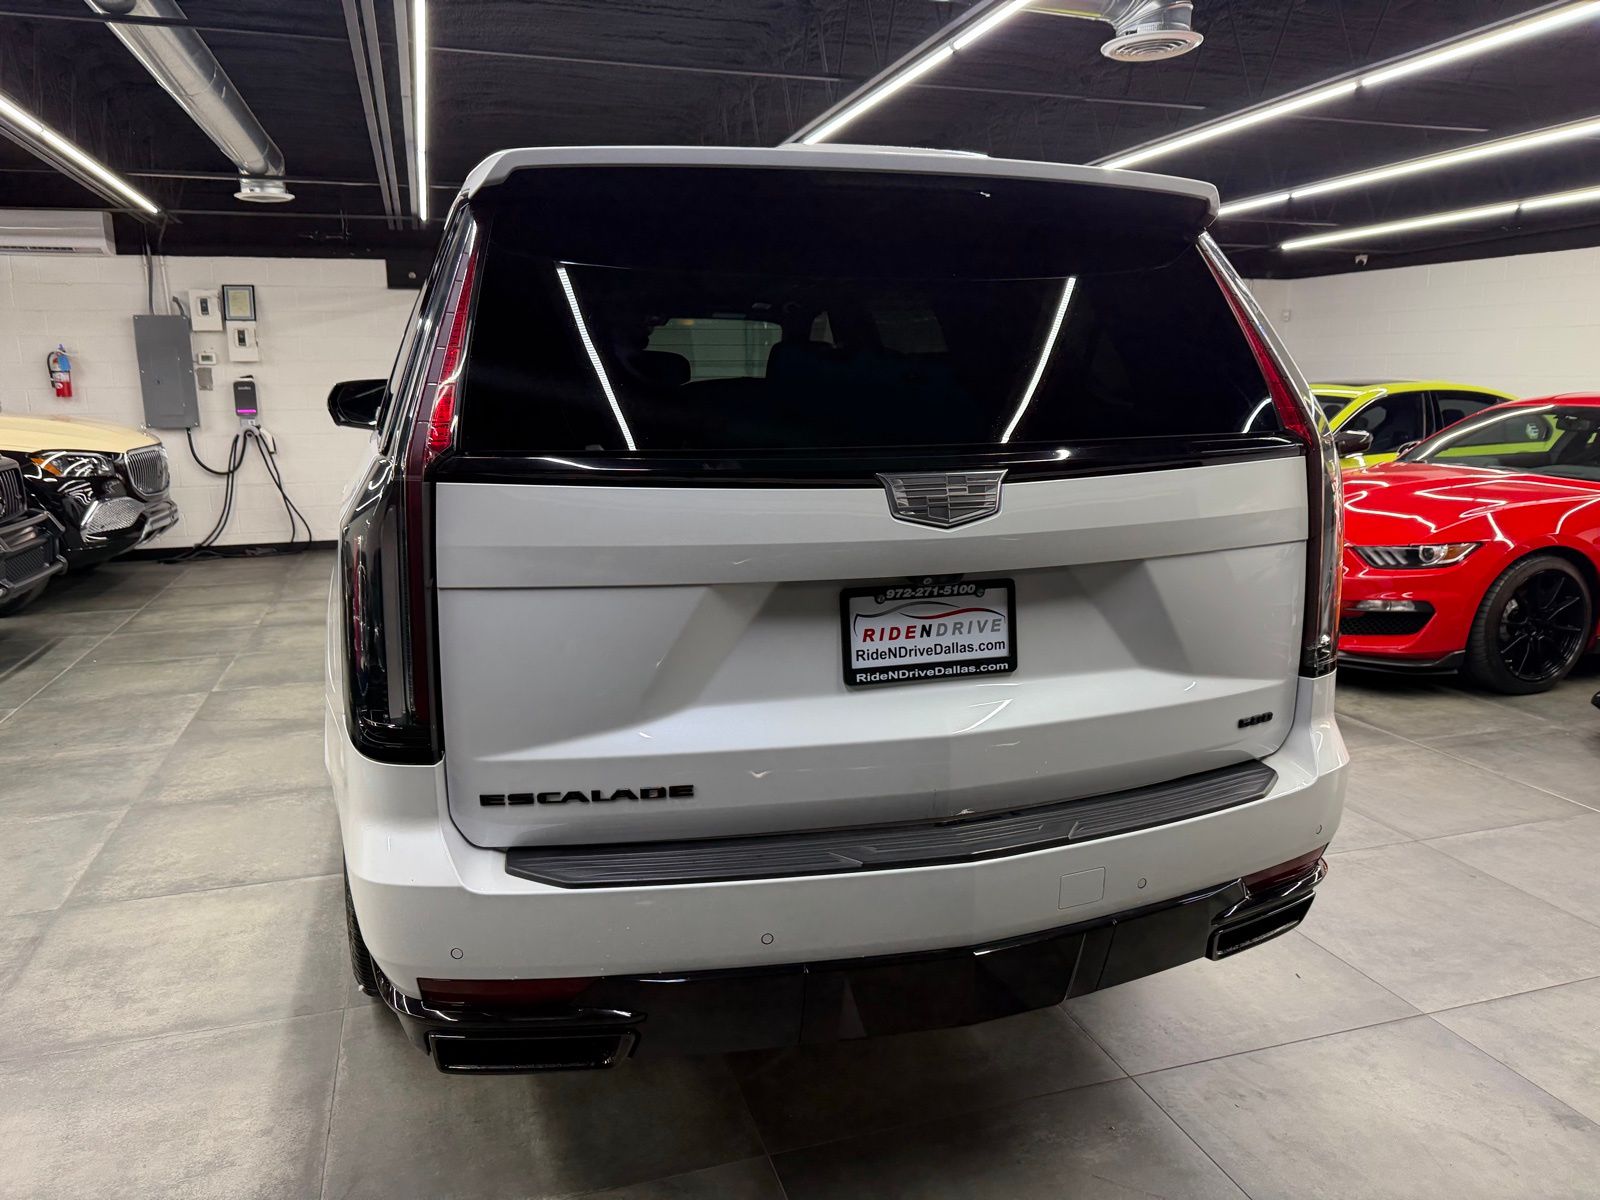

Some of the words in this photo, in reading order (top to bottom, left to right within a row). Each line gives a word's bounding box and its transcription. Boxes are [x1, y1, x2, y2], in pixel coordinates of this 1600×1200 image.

[886, 584, 976, 599] 972-271-5100
[862, 618, 1002, 643] RIDENDRIVE
[856, 640, 1006, 662] RideNDriveDallas.com
[856, 662, 1009, 683] RideNDriveDallas.com
[479, 784, 694, 806] ESCALADE
